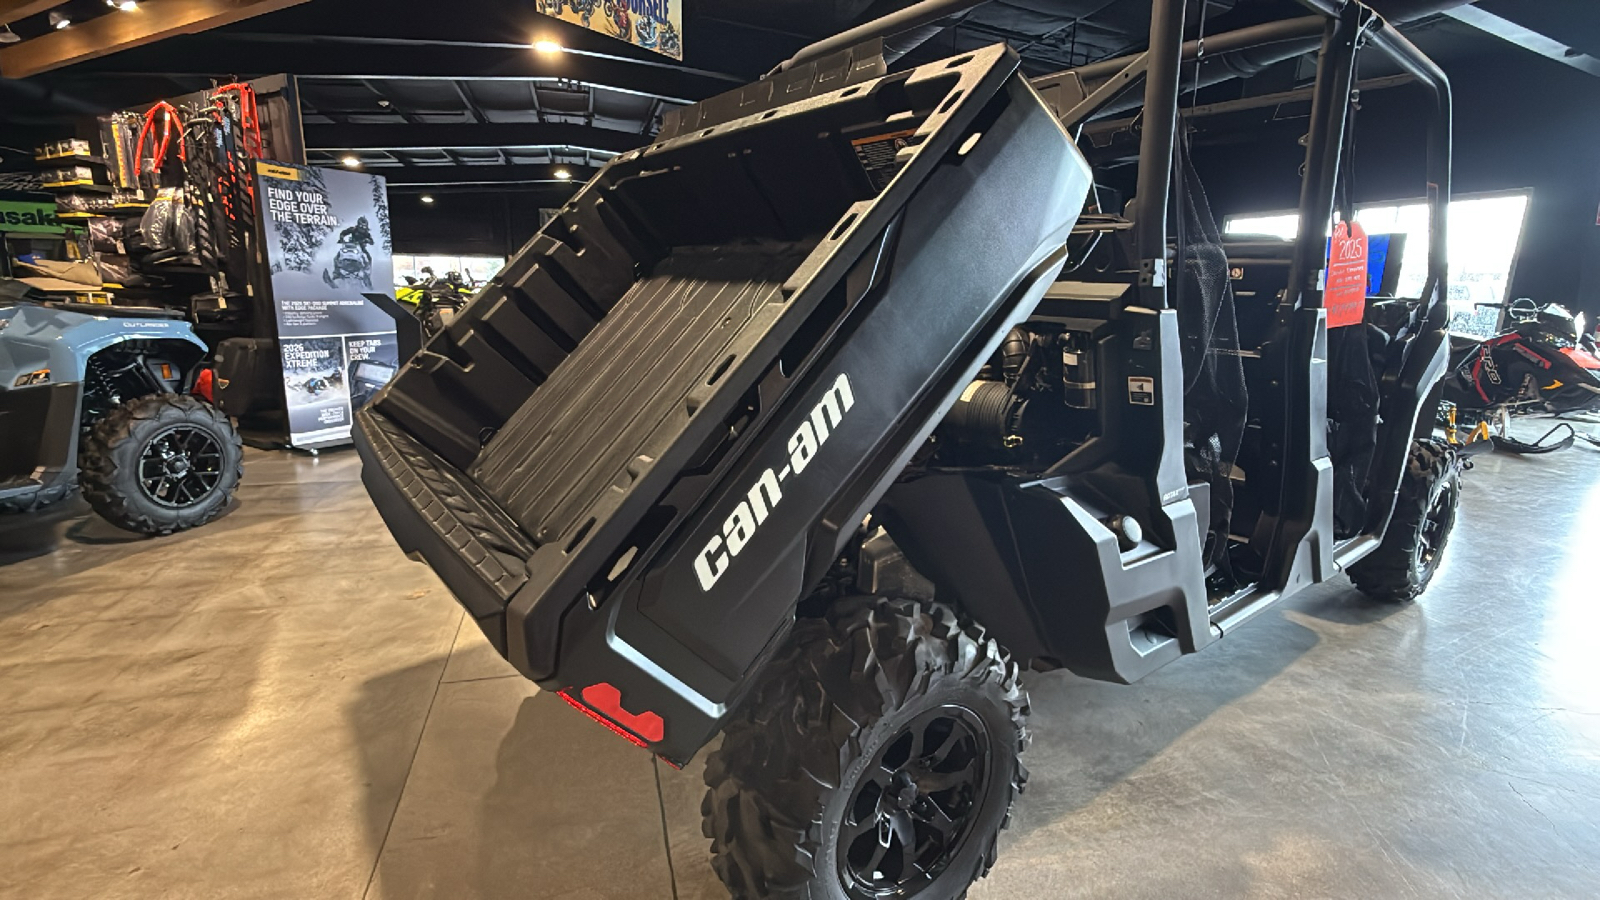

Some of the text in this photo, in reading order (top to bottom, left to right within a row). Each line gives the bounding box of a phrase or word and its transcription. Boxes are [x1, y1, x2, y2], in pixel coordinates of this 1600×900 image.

[268, 187, 324, 204] FIND YOUR
[269, 198, 328, 215] EDGE OVER
[269, 210, 340, 226] THE TERRAIN.
[1339, 238, 1362, 260] 2025
[283, 343, 304, 353] 2026
[348, 340, 365, 348] KEEP
[284, 350, 330, 360] EXPEDITION
[286, 358, 318, 368] XTREME
[694, 372, 855, 592] can-am
